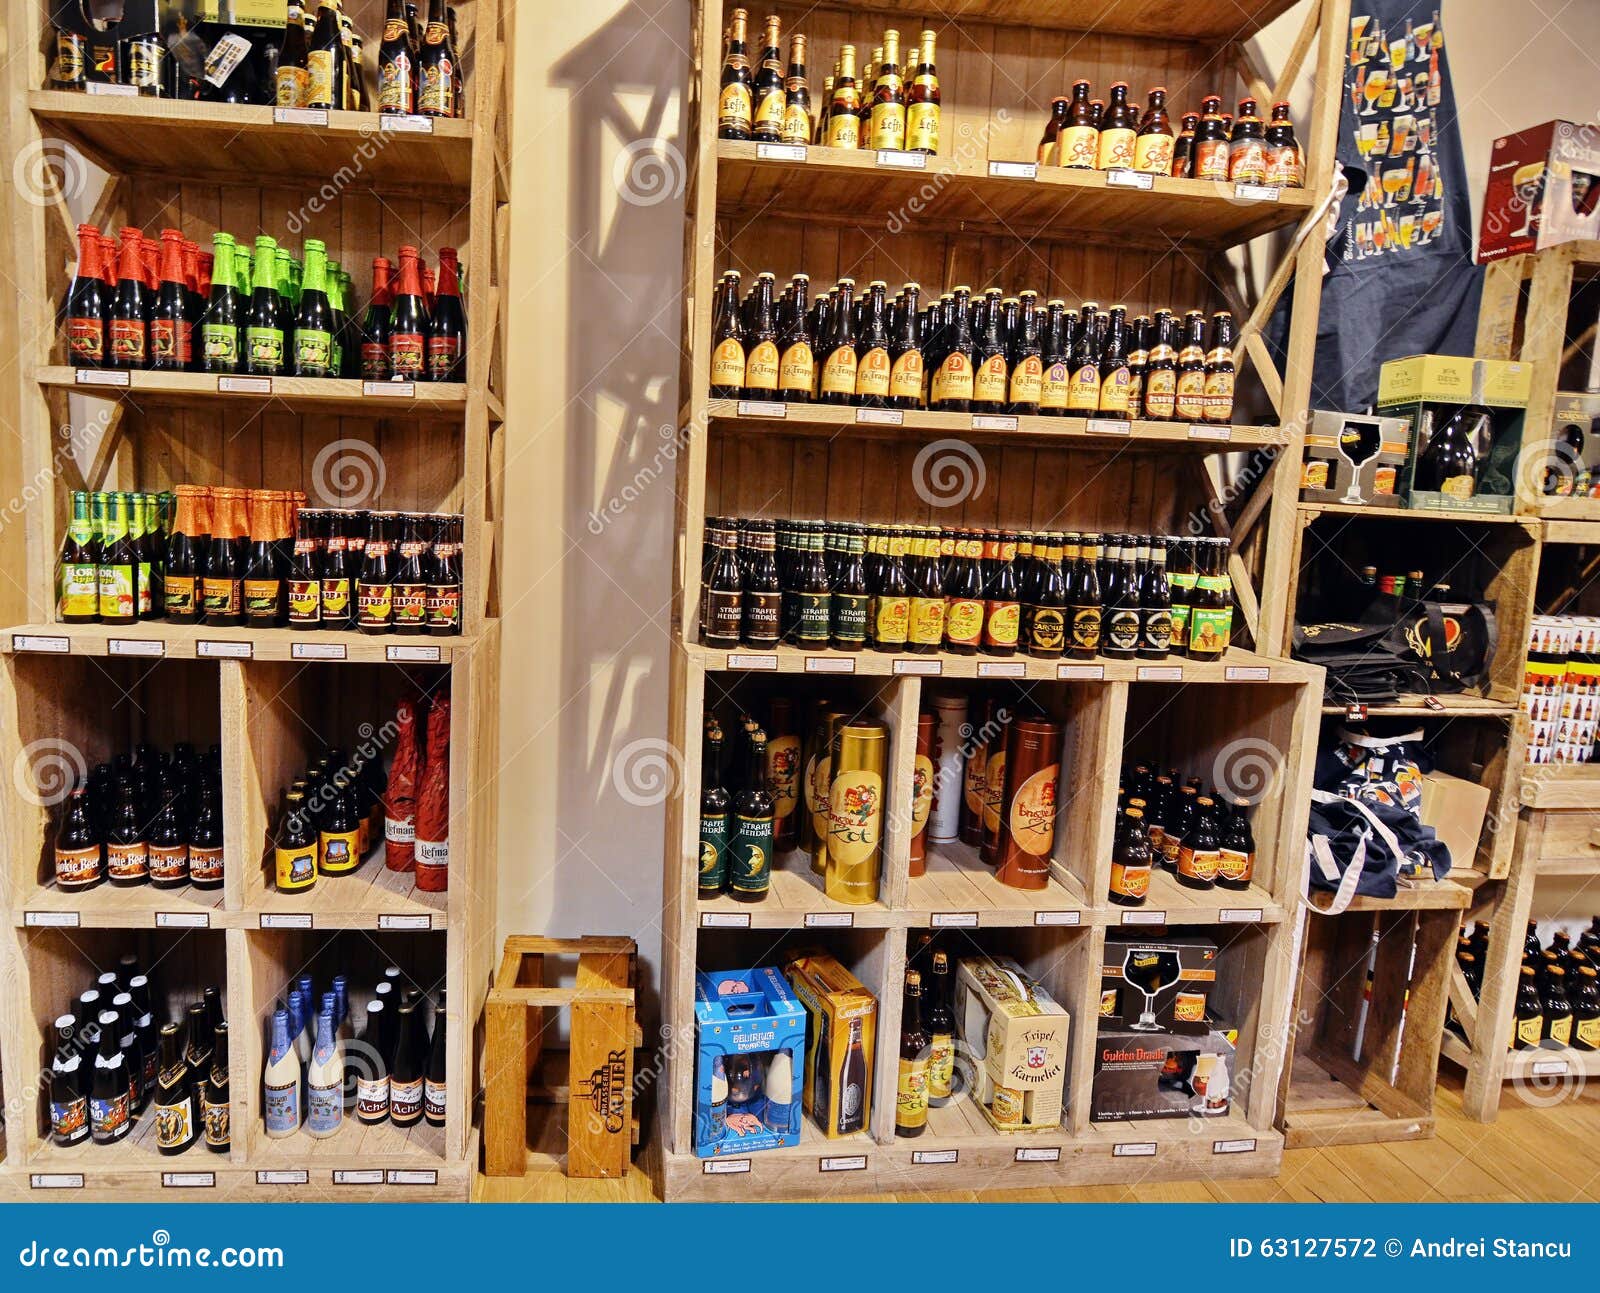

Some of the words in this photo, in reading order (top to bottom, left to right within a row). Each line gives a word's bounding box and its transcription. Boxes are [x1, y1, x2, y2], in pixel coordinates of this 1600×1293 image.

[724, 97, 746, 113] Leffe
[769, 104, 785, 118] Lef
[386, 820, 415, 836] Liefman
[702, 826, 726, 834] NDRIK
[829, 824, 873, 843] Zot
[421, 845, 448, 859] Liefma
[80, 857, 99, 869] Beer
[128, 854, 147, 866] Beer
[166, 856, 186, 867] Beer
[1023, 1030, 1055, 1043] Tripel
[1103, 1049, 1135, 1061] Gulden
[1136, 1048, 1164, 1061] Draak
[1011, 1065, 1061, 1083] Karmeliet
[425, 1104, 445, 1113] che
